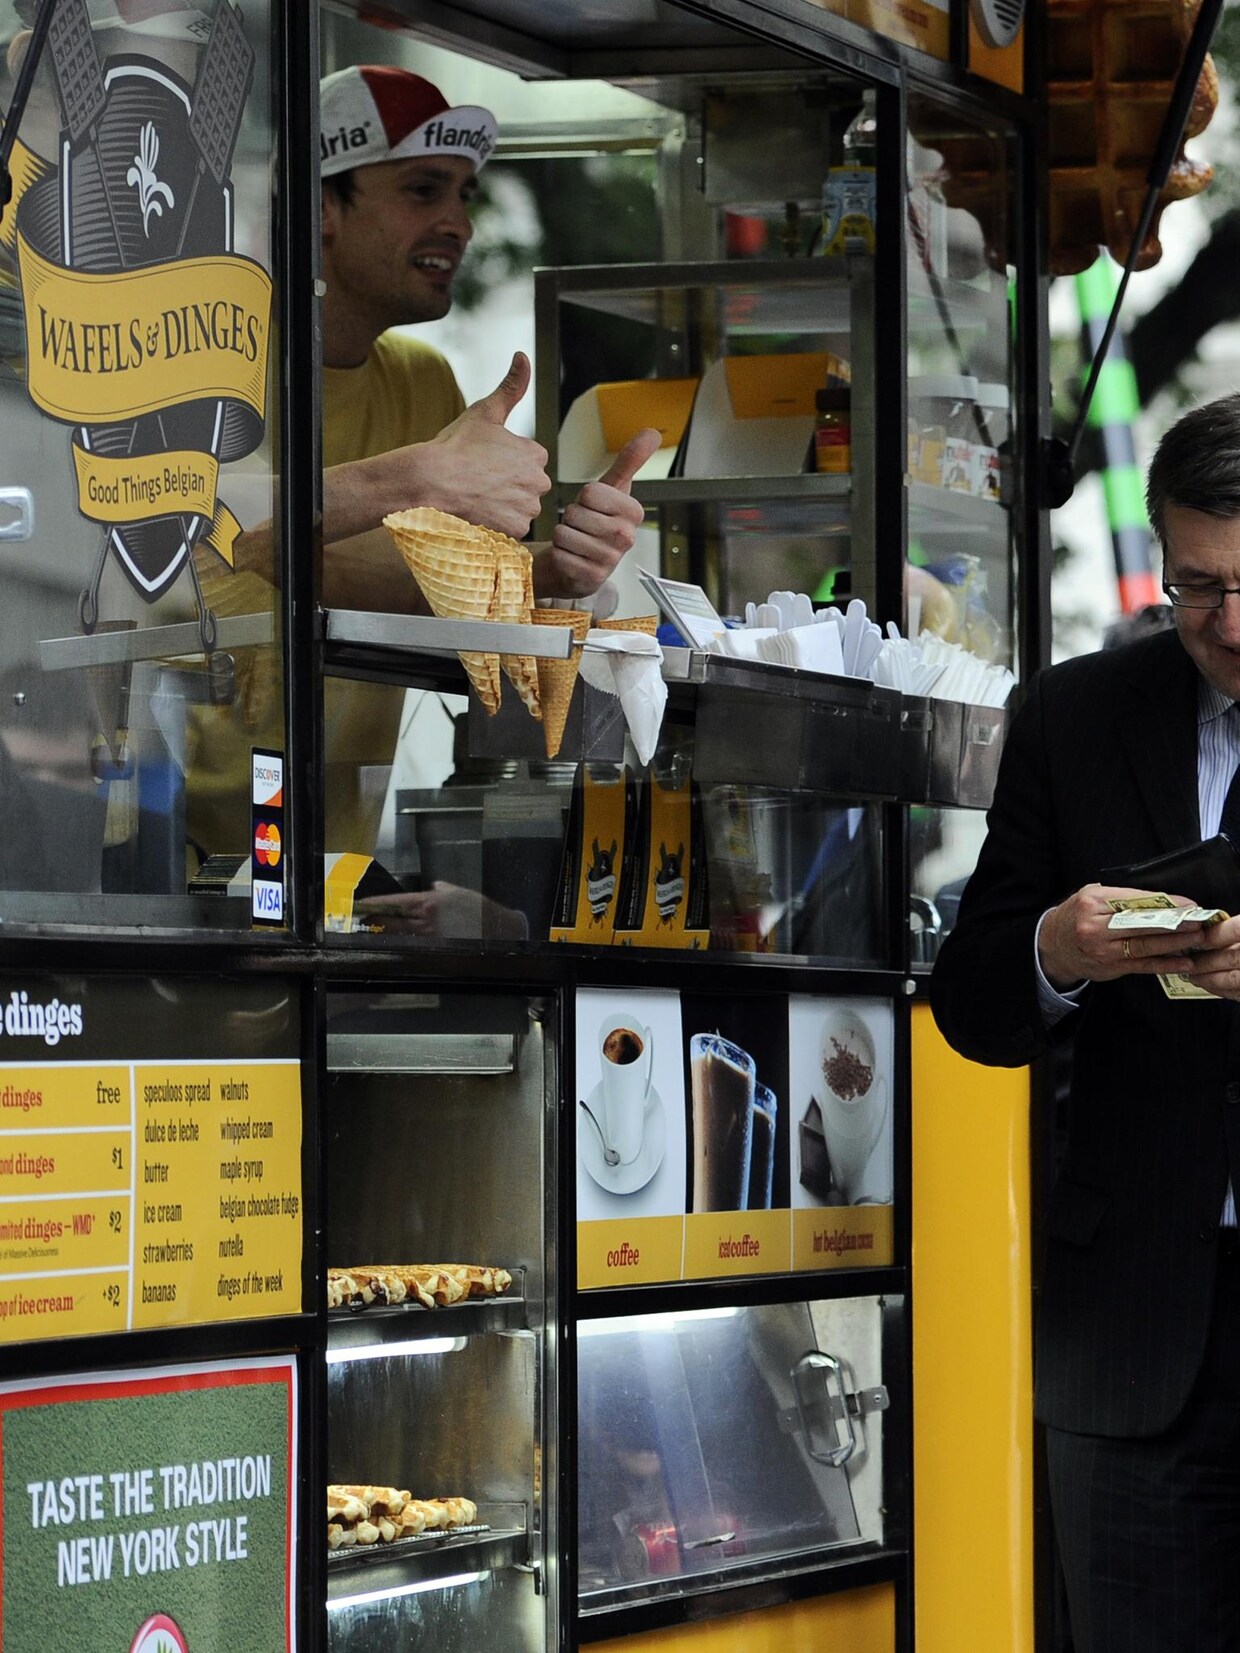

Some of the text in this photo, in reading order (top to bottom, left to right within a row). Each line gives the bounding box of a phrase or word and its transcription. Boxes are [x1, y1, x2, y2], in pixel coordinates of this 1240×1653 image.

[37, 300, 259, 375] WAFELS & DINGES
[87, 464, 206, 505] Good Things Belgian
[255, 767, 281, 782] DISCOVER
[255, 887, 281, 912] VISA
[4, 990, 84, 1046] dinges
[1, 1080, 121, 1112] dinges free
[144, 1077, 211, 1108] speculoos spread
[219, 1077, 249, 1101] walnuts
[144, 1117, 199, 1143] dulce de leche
[219, 1116, 274, 1145] whipped cream
[15, 1152, 55, 1179] dinges
[111, 1146, 123, 1170] $1
[144, 1159, 169, 1183] butter
[219, 1155, 264, 1184] maple syrup
[143, 1200, 182, 1224] ice cream
[219, 1191, 299, 1224] belgian chocolate fudge
[24, 1217, 63, 1243] dinges
[108, 1210, 122, 1235] $2
[142, 1237, 194, 1264] strawberries
[218, 1233, 244, 1259] nutella
[606, 1241, 640, 1268] coffee
[730, 1233, 760, 1257] coffee
[142, 1279, 177, 1304] bananas
[217, 1268, 283, 1301] dinges of the week
[18, 1292, 35, 1315] ice
[36, 1295, 74, 1314] cream
[27, 1454, 271, 1529] TASTE THE TRADITION
[57, 1515, 249, 1587] NEW YORK STYLE
